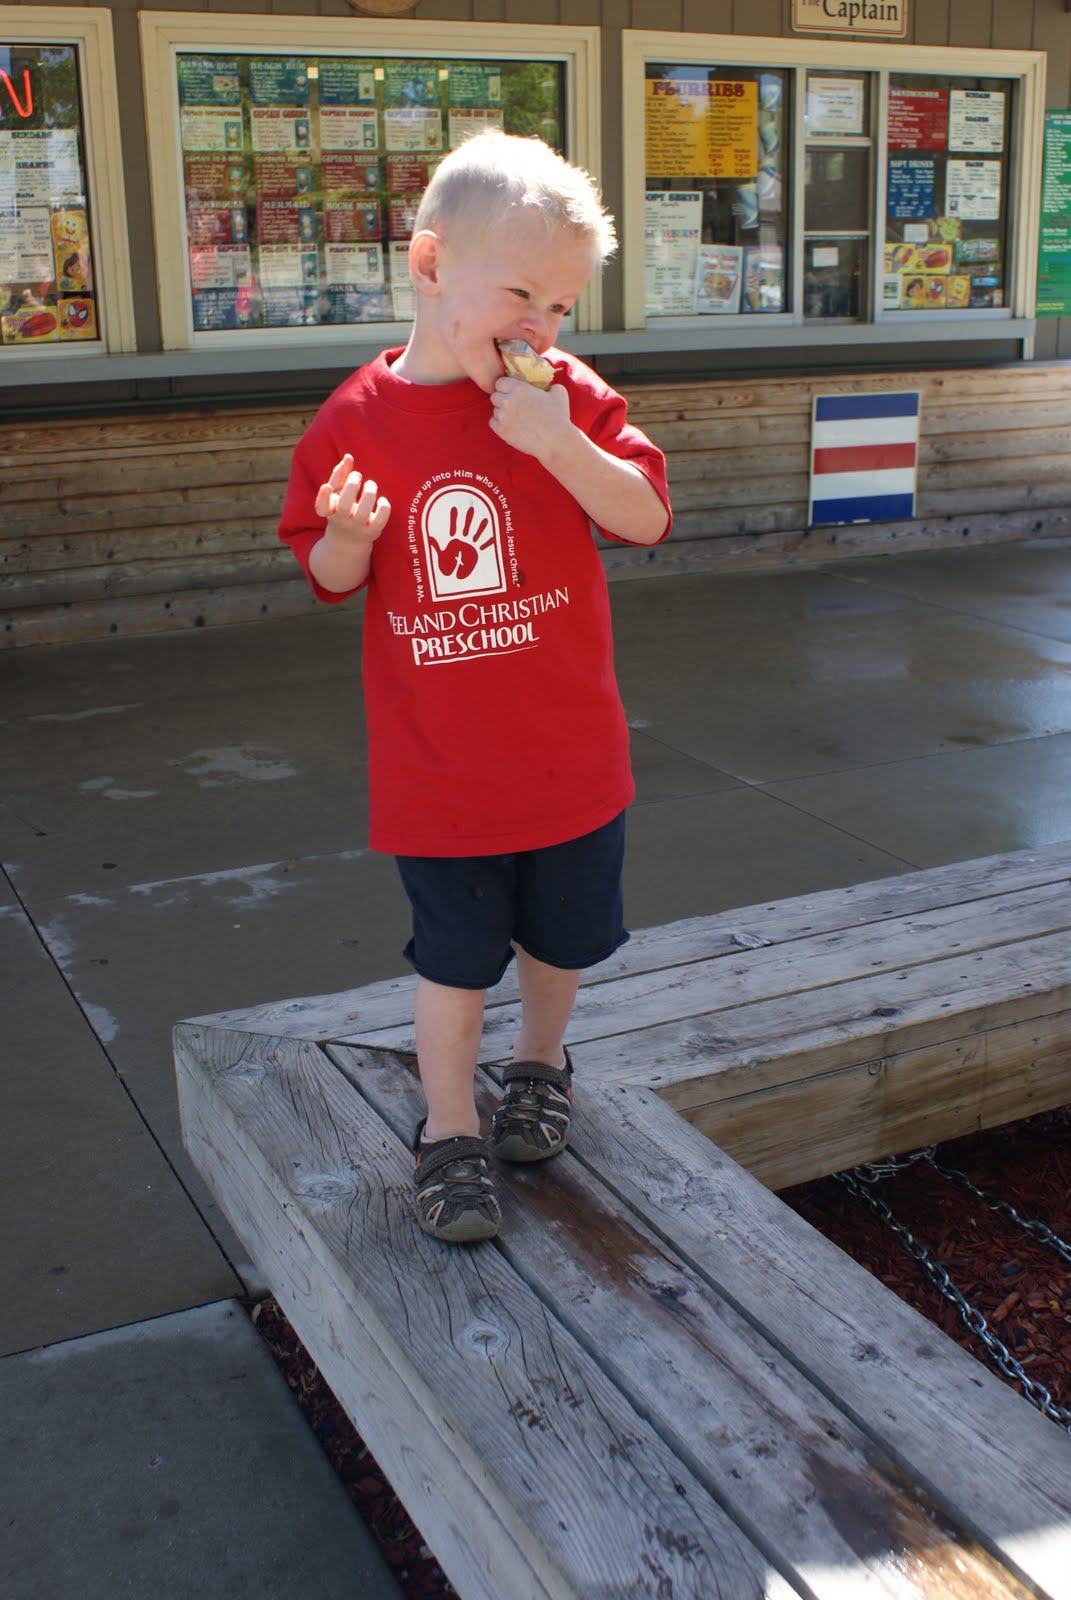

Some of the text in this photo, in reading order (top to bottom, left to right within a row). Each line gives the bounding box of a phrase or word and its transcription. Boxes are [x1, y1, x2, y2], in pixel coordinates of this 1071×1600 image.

[822, 0, 899, 26] Captain
[652, 81, 745, 97] FLURRIES
[262, 200, 311, 209] MERMAID
[432, 471, 452, 483] into
[453, 469, 474, 479] Him
[475, 473, 494, 488] who
[421, 480, 432, 491] up
[492, 485, 500, 495] is
[409, 490, 423, 514] grow
[498, 493, 508, 510] the
[408, 515, 416, 543] things
[504, 510, 514, 534] head,
[409, 544, 418, 555] all
[507, 535, 516, 557] Jesus
[412, 558, 420, 567] in
[413, 568, 423, 584] will
[458, 586, 570, 627] CHRISTIAN
[411, 621, 540, 666] PRESCHOOL
